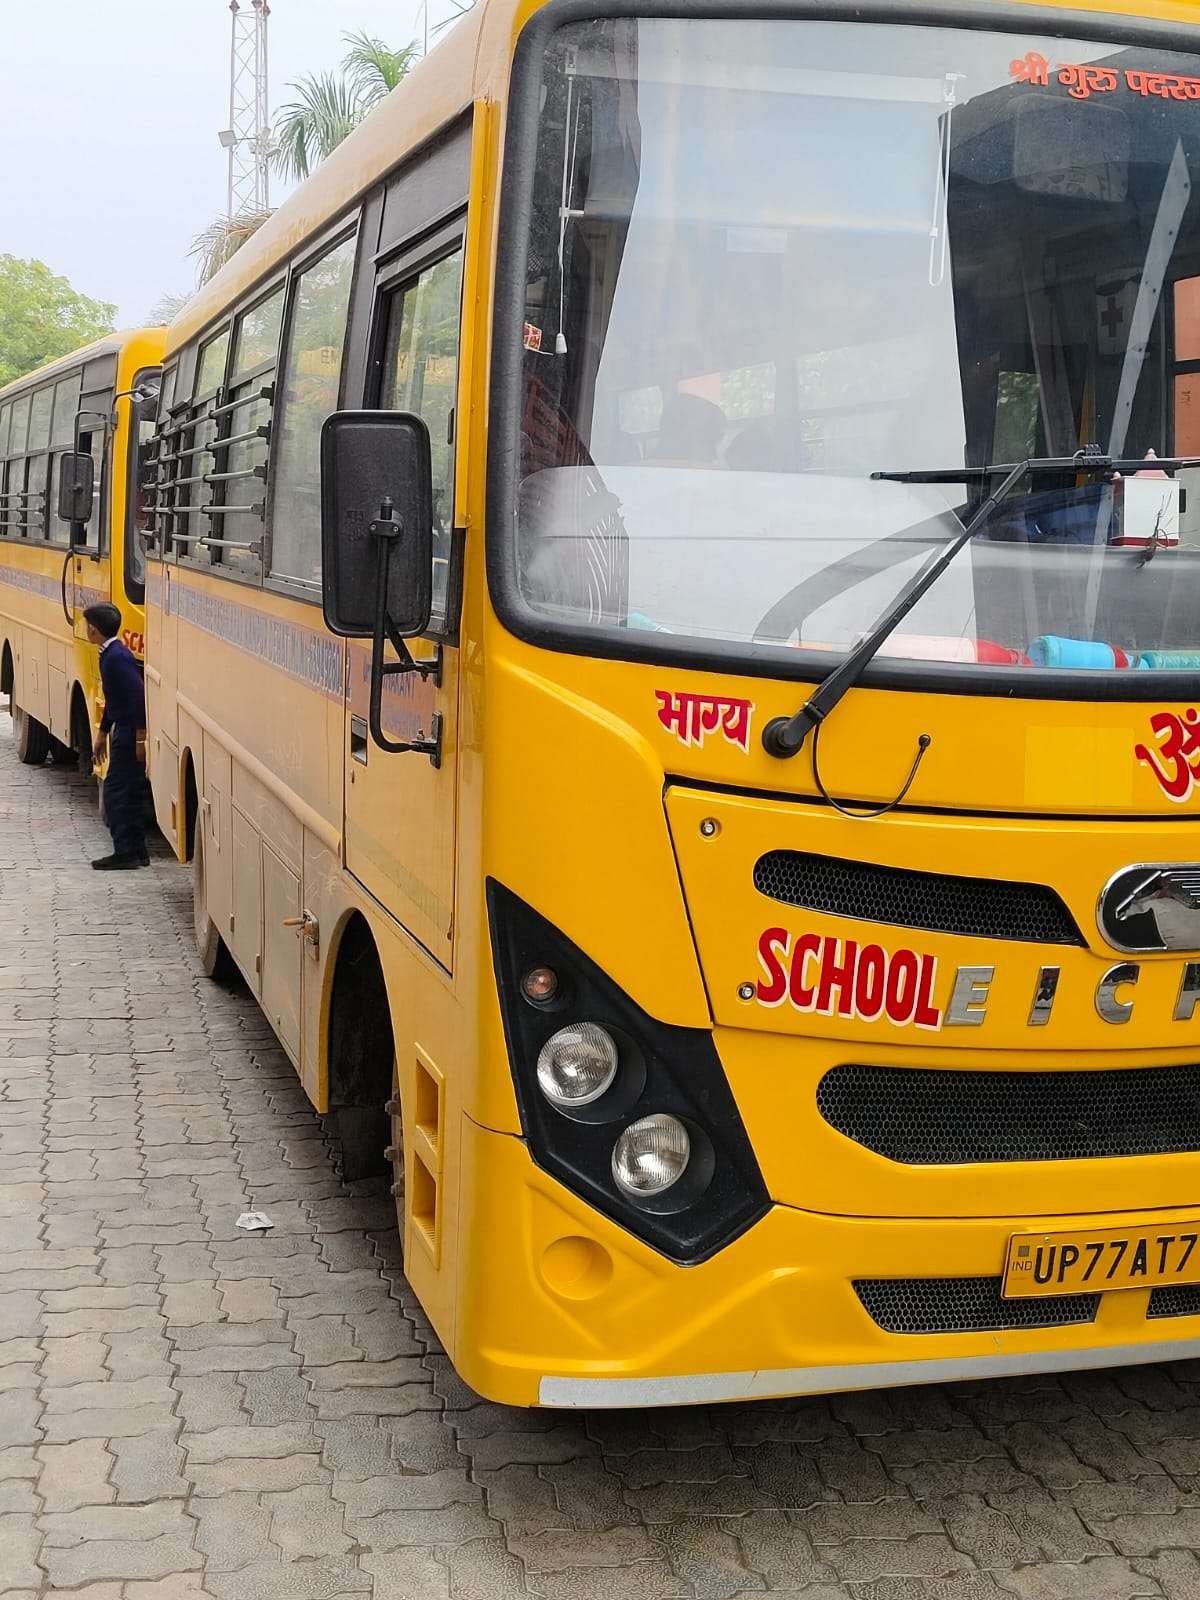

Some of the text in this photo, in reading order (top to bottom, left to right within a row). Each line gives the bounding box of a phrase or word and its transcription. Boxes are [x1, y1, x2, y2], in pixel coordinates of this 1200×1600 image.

[1008, 50, 1049, 86] श्री
[756, 926, 942, 1031] SCHOOL
[1012, 1260, 1033, 1271] IND
